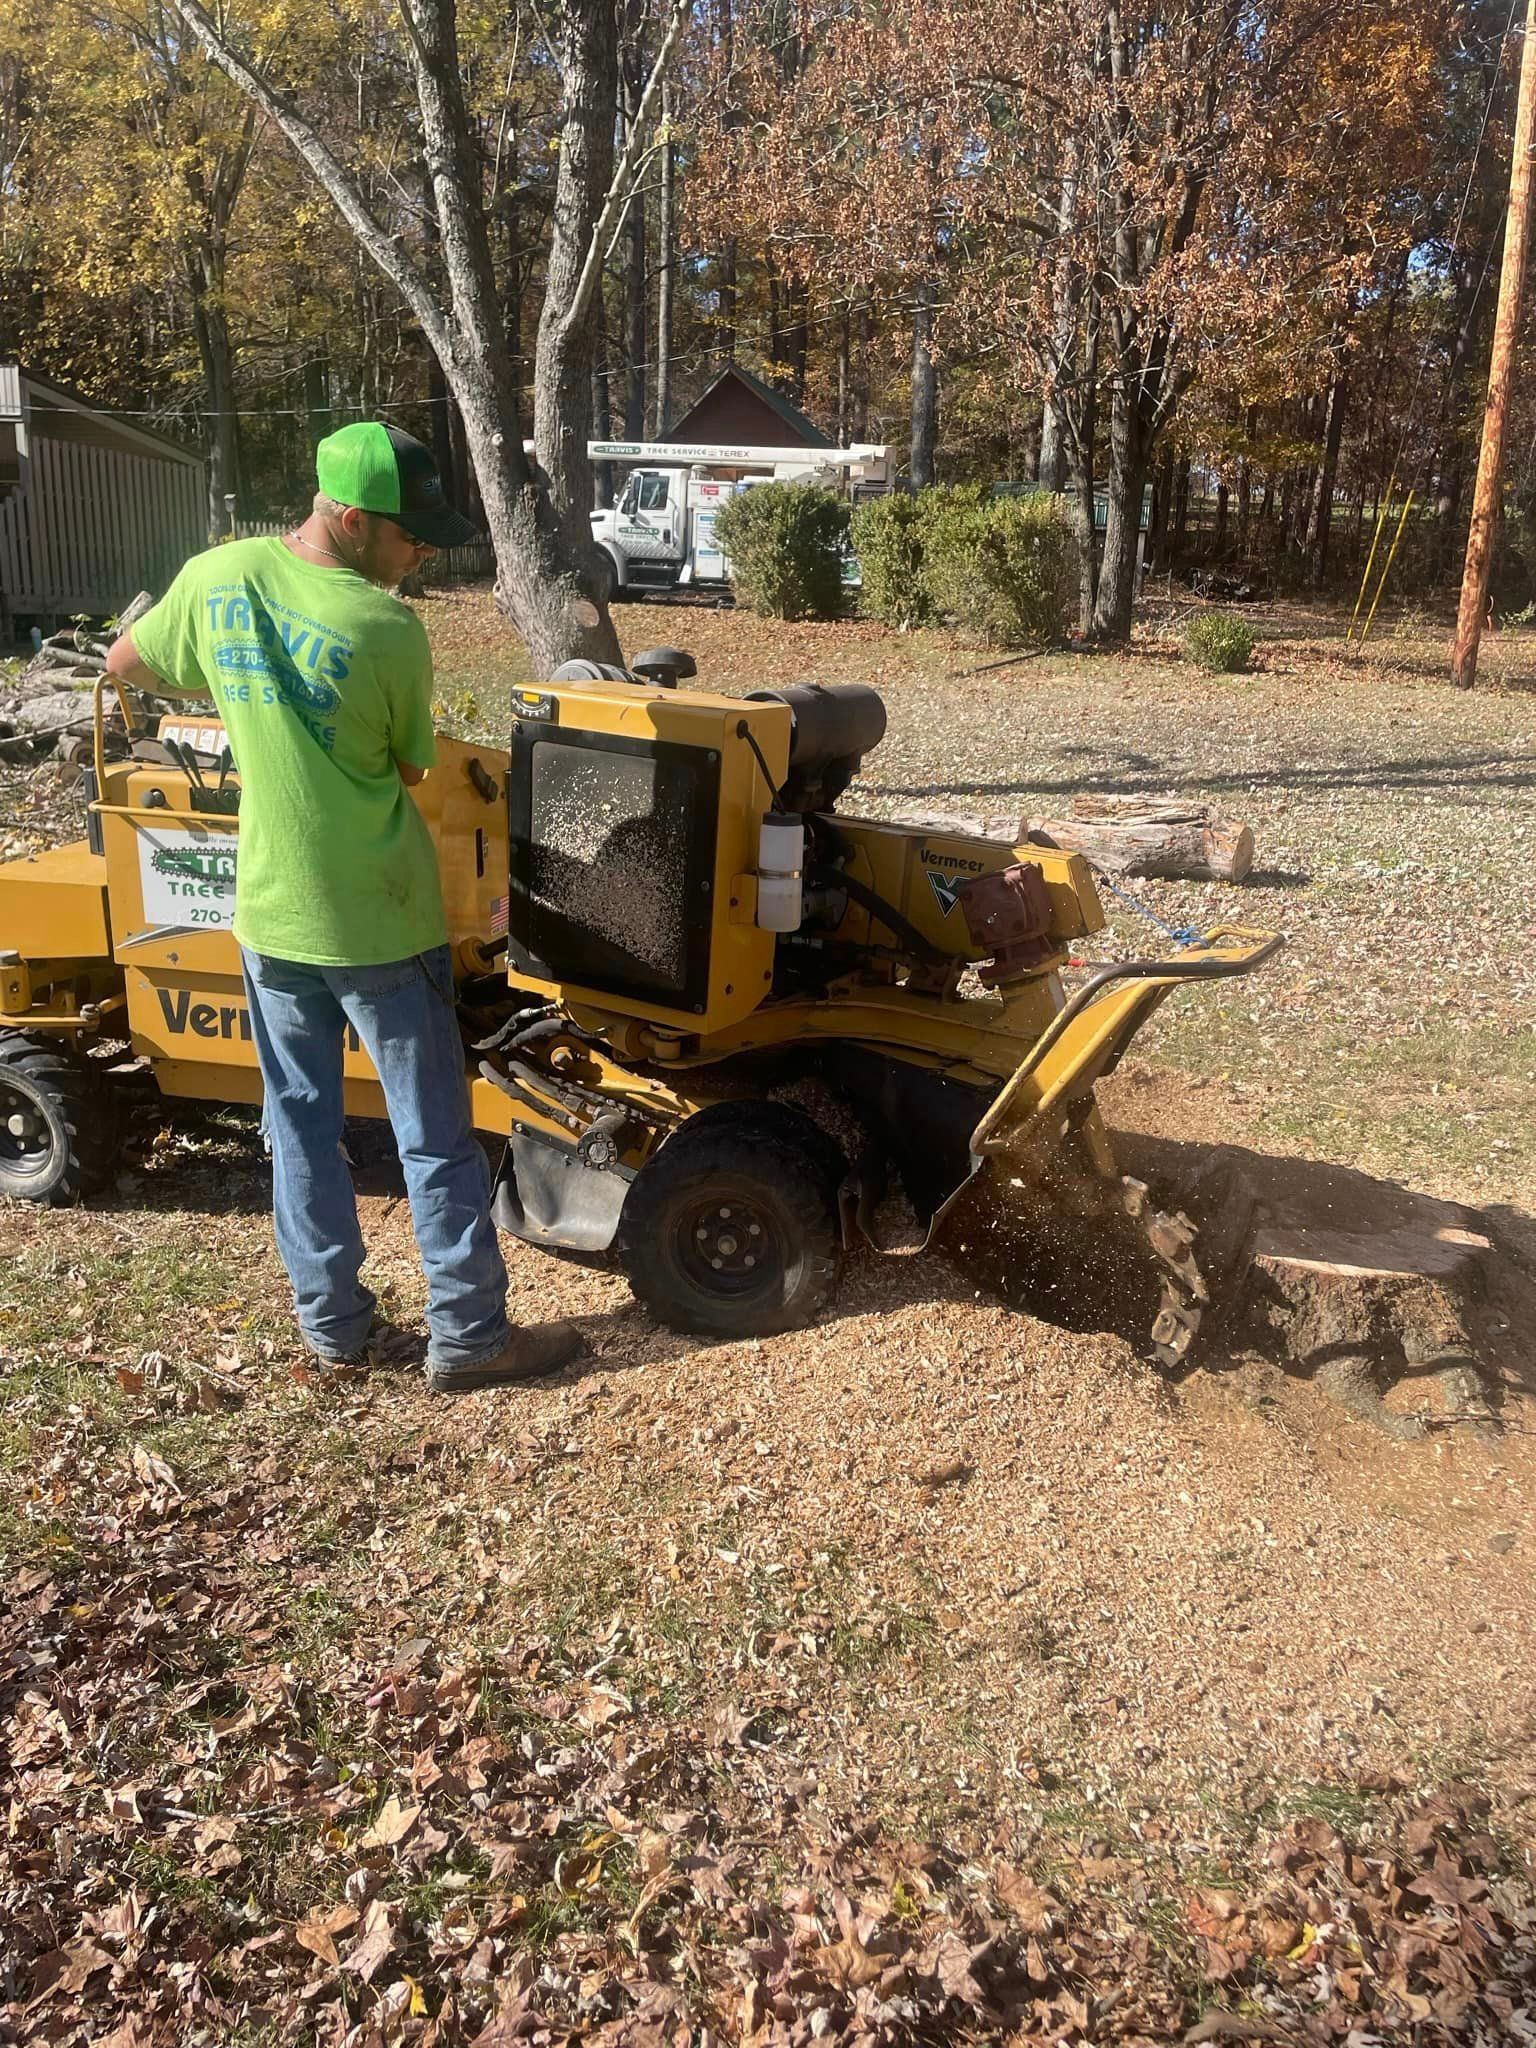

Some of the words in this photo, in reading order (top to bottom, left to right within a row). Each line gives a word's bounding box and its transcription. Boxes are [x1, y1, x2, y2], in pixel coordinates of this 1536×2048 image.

[647, 447, 668, 455] TREE
[671, 448, 707, 456] SERVICE
[719, 450, 751, 458] TEREX
[286, 608, 302, 621] NOT
[207, 597, 353, 680] TRAVIS
[920, 848, 984, 873] Vermeer
[168, 881, 225, 899] TREE
